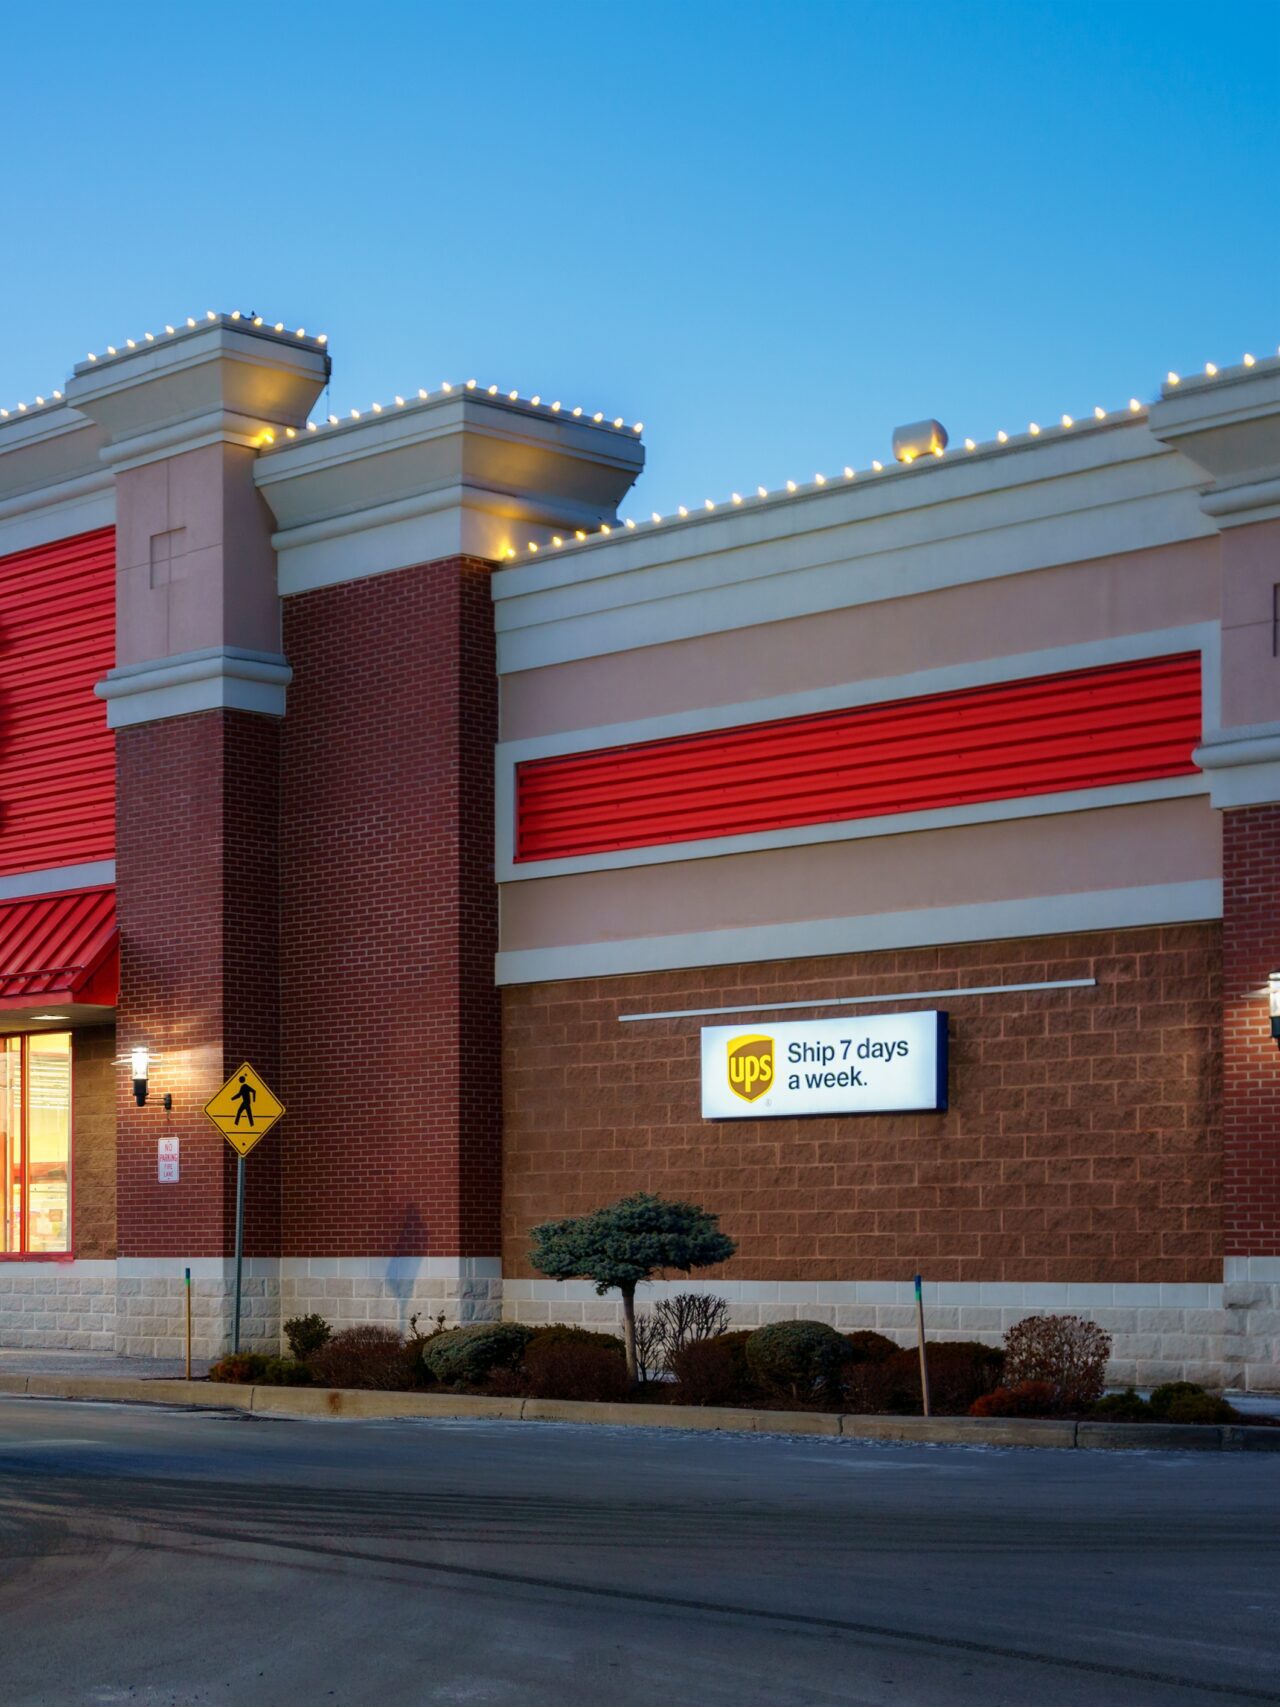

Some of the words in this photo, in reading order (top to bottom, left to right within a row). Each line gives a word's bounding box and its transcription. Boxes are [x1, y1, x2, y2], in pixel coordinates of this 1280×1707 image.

[788, 1041, 835, 1066] Ship
[840, 1039, 852, 1060] 7
[857, 1038, 909, 1062] days
[730, 1055, 772, 1093] ups
[788, 1074, 800, 1089] a
[805, 1066, 868, 1088] week.
